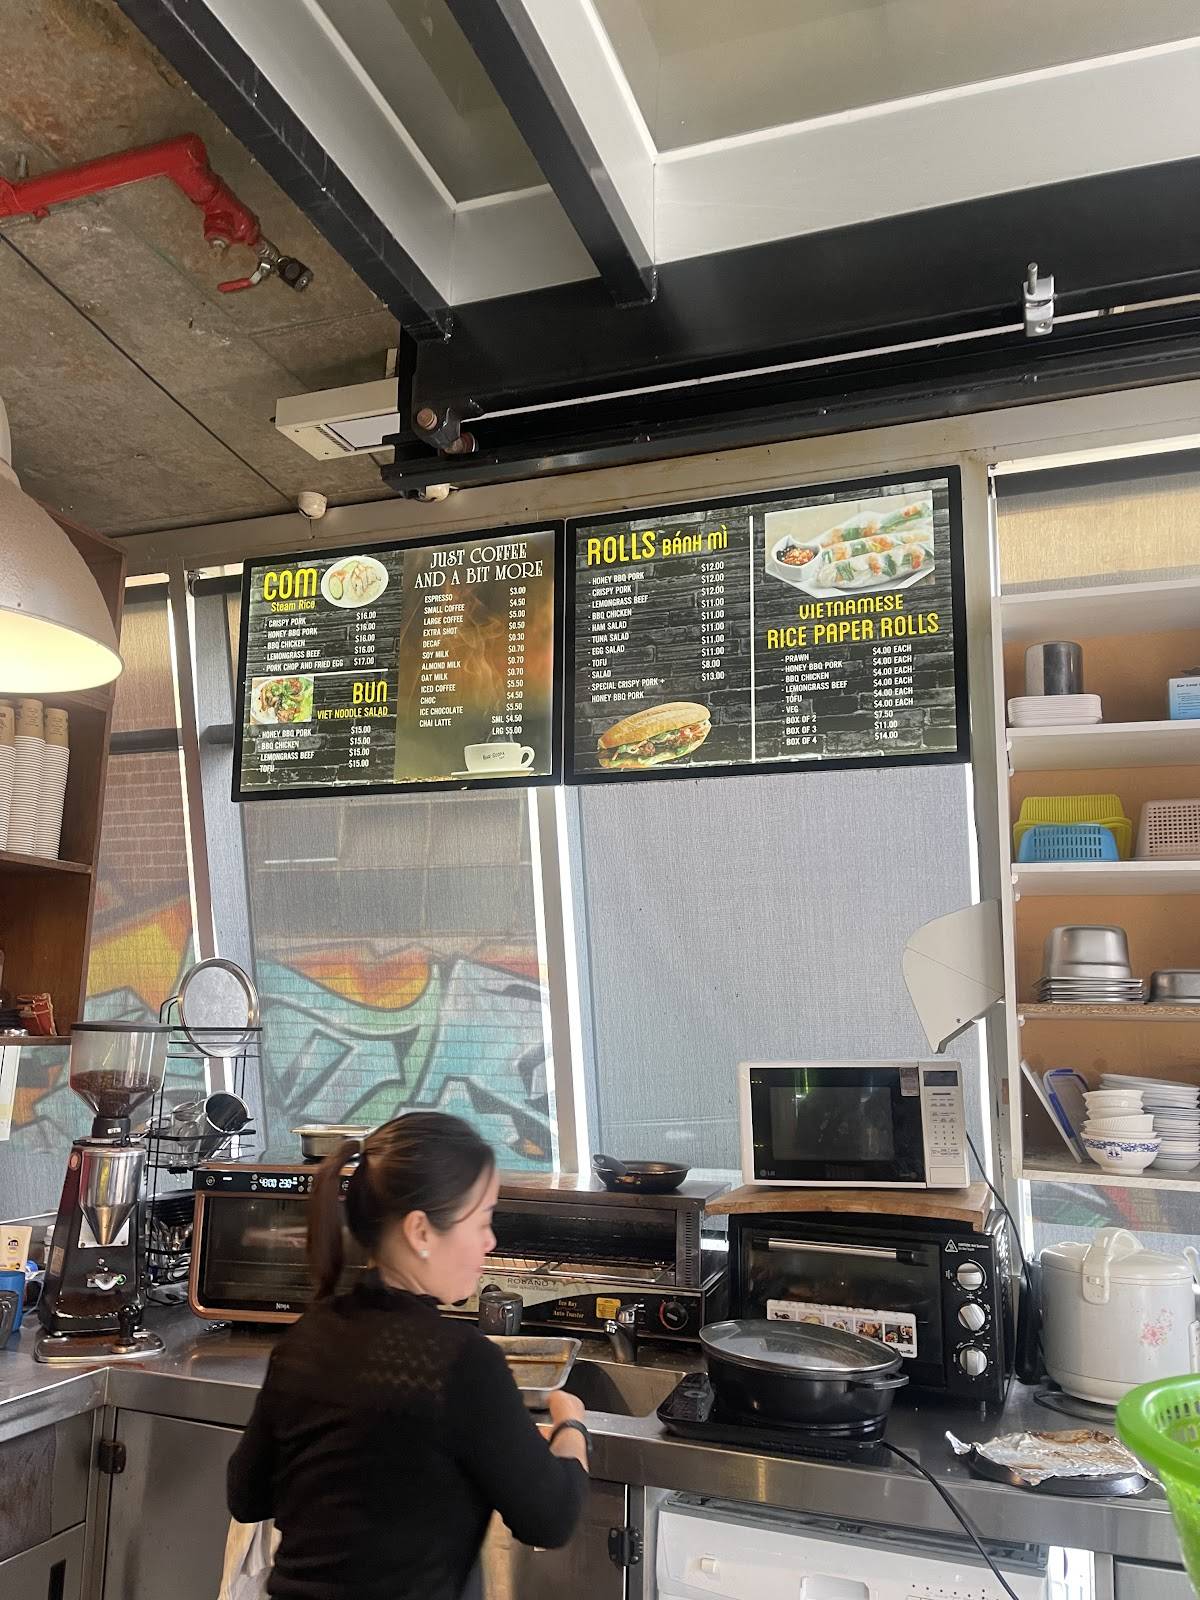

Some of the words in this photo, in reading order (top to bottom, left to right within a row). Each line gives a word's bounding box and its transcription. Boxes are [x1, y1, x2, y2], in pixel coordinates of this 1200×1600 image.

[587, 530, 656, 565] ROLLS
[431, 549, 465, 568] JUST
[470, 542, 527, 564] COFFEE
[702, 561, 724, 572] $12.00
[414, 571, 445, 588] AND
[451, 569, 460, 585] A
[466, 566, 490, 584] BIT
[495, 560, 543, 581] MORE
[592, 577, 612, 585] HONEY
[614, 574, 626, 582] BBQ
[628, 572, 644, 580] PORK
[702, 573, 724, 584] $12.00
[264, 568, 317, 600] COM
[592, 588, 614, 597] CRISPY
[616, 585, 632, 594] PORK
[702, 586, 724, 596] $12.00
[424, 594, 452, 603] ESPRESSO
[510, 598, 525, 607] $4.50
[592, 597, 632, 608] LEMONGRASS
[634, 595, 648, 604] BEEF
[702, 598, 724, 608] $11.00
[271, 602, 295, 612] Steam
[299, 600, 315, 610] Rice
[424, 606, 443, 614] SMALL
[444, 604, 464, 612] COFFEE
[800, 594, 904, 620] VIETNAMESE
[592, 612, 604, 620] BBQ
[606, 609, 632, 618] CHICKEN
[702, 610, 724, 620] $11.00
[269, 619, 289, 627] CRISPY
[291, 618, 306, 626] PORK
[424, 617, 441, 625] LARGE
[443, 615, 464, 624] COFFEE
[423, 628, 440, 636] EXTRA
[443, 627, 457, 635] SHOT
[592, 624, 605, 632] HAM
[608, 621, 627, 630] SALAD
[702, 622, 724, 632] $11.00
[767, 626, 806, 649] RICE
[815, 619, 873, 644] PAPER
[881, 612, 939, 638] ROLLS
[268, 630, 287, 638] HONEY
[288, 629, 300, 637] BBQ
[592, 635, 608, 644] TUNA
[610, 632, 629, 642] SALAD
[702, 634, 724, 644] $11.00
[606, 645, 624, 654] SALAD
[702, 646, 724, 657] $11.00
[873, 646, 891, 655] $4.00
[894, 644, 911, 653] EACH
[267, 651, 304, 660] LEMONGRASS
[785, 654, 809, 663] PRAWN
[873, 657, 891, 666] $4.00
[894, 655, 912, 664] EACH
[283, 662, 299, 671] CHOP
[300, 662, 312, 670] AND
[314, 660, 330, 668] FRIED
[354, 657, 374, 666] $17.00
[422, 662, 445, 671] ALMOND
[592, 659, 607, 667] TOFU
[785, 664, 807, 673] HONEY
[809, 662, 822, 671] BBQ
[824, 661, 842, 669] PORK
[873, 668, 892, 677] $4.00
[894, 666, 912, 675] EACH
[592, 670, 611, 679] SALAD
[785, 674, 799, 683] BBQ
[801, 672, 829, 681] CHICKEN
[592, 682, 616, 691] SPECIAL
[618, 680, 640, 688] CRISPY
[642, 678, 658, 687] PORK
[873, 678, 892, 687] $4.00
[894, 676, 912, 685] EACH
[436, 684, 456, 692] COFFEE
[786, 682, 829, 693] LEMONGRASS
[832, 681, 848, 689] BEEF
[353, 681, 388, 704] BUN
[592, 694, 612, 703] HONEY
[614, 693, 626, 701] BBQ
[628, 691, 644, 699] PORK
[873, 689, 892, 698] $4.00
[894, 687, 913, 696] EACH
[420, 696, 436, 704] CHOC
[786, 695, 802, 704] TOFU
[874, 699, 892, 708] $4.00
[895, 698, 913, 706] EACH
[318, 710, 332, 720] VIET
[334, 708, 362, 719] NOODLE
[364, 706, 388, 716] SALAD
[430, 706, 463, 715] CHOCOLATE
[874, 710, 893, 719] $7.50
[435, 718, 452, 726] LATTE
[786, 716, 800, 724] BOX
[875, 721, 898, 729] $11.00
[351, 726, 371, 734] $15.00
[786, 726, 800, 735] BOX
[875, 731, 898, 740] $14.00
[275, 741, 299, 749] CHICKEN
[350, 737, 370, 745] $15.00
[786, 737, 800, 746] BOX
[260, 752, 298, 761] LEMONGRASS
[300, 751, 314, 759] BEEF
[349, 748, 369, 756] $15.00
[348, 760, 369, 768] $15.00
[508, 1278, 548, 1287] ROBAND
